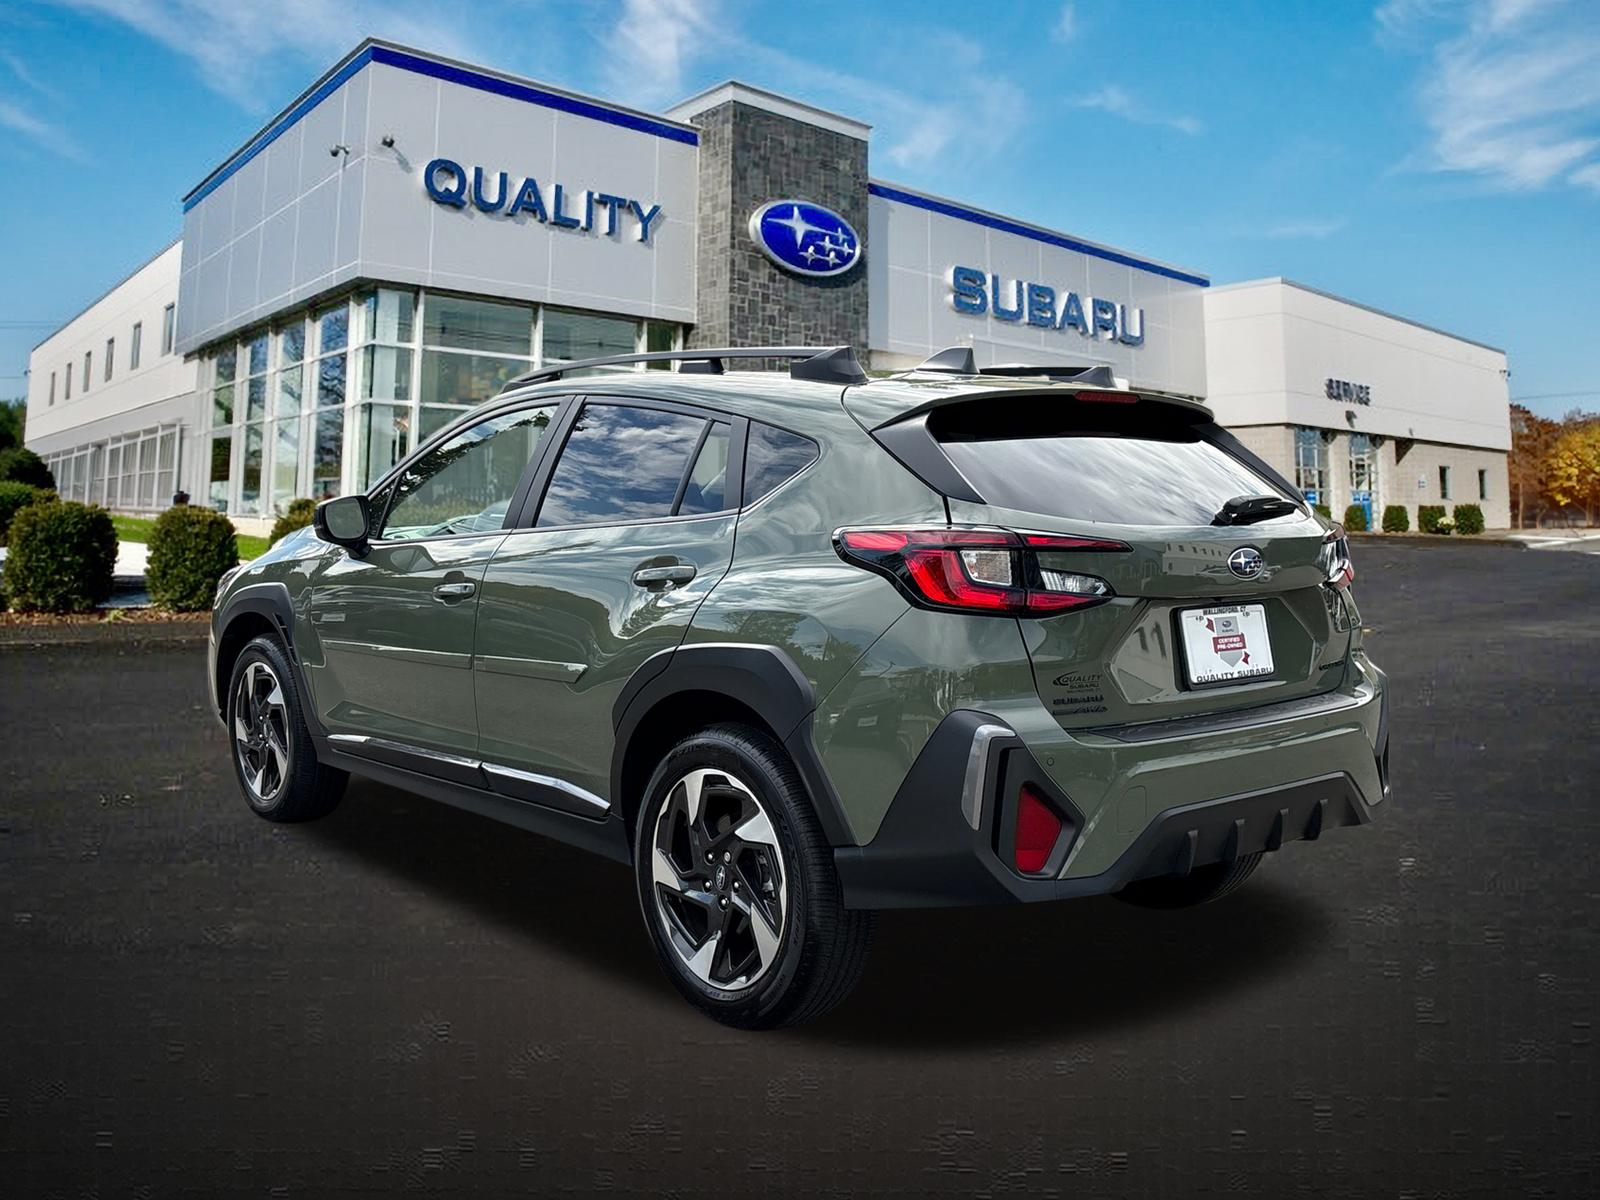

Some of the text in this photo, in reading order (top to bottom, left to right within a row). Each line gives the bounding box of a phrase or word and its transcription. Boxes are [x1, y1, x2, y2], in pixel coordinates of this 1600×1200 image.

[423, 157, 662, 243] QUALITY
[948, 265, 1145, 346] SUBARU
[1325, 378, 1371, 406] SERVICE
[1061, 674, 1102, 683] QUALITY
[1196, 667, 1272, 683] QUALITY SUBARU
